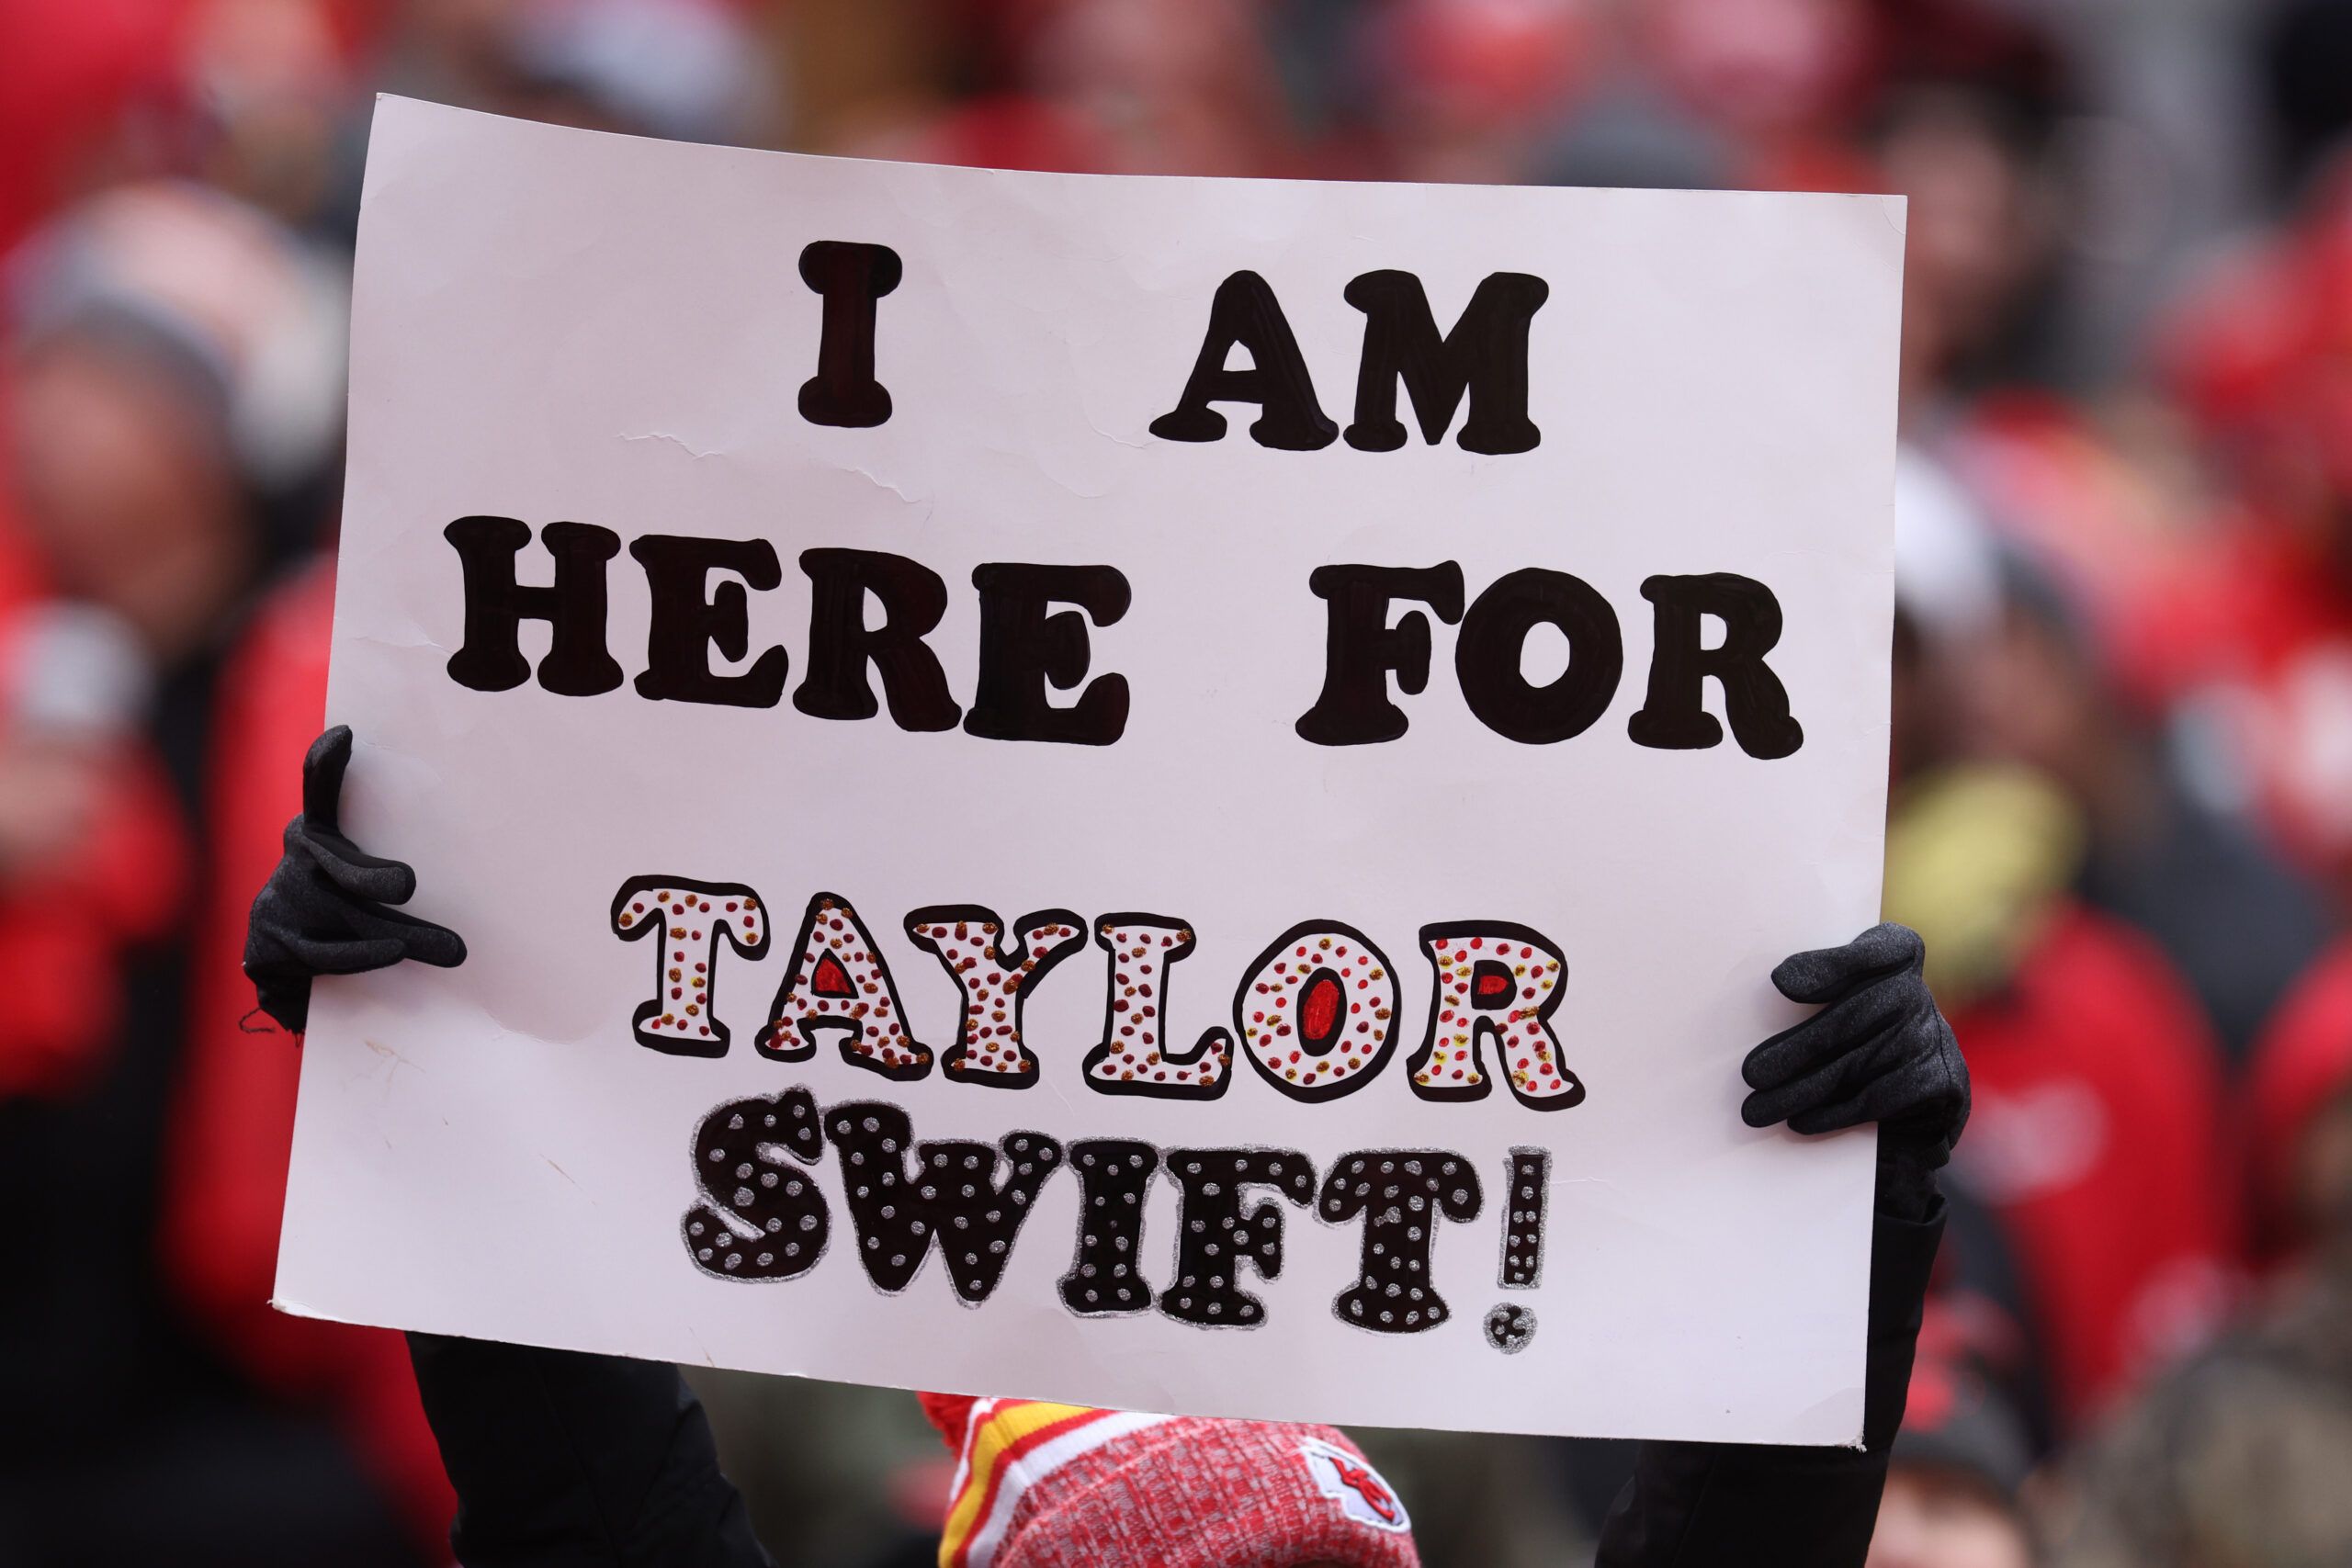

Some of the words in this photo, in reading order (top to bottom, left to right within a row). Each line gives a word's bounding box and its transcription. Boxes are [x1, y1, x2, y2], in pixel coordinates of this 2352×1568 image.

[797, 240, 903, 429] I
[1148, 268, 1550, 456] AM
[443, 514, 1132, 747] HERE
[1295, 559, 1804, 761] FOR
[610, 874, 1587, 1111] TAYLOR
[680, 1083, 1553, 1356] SWIFT!
